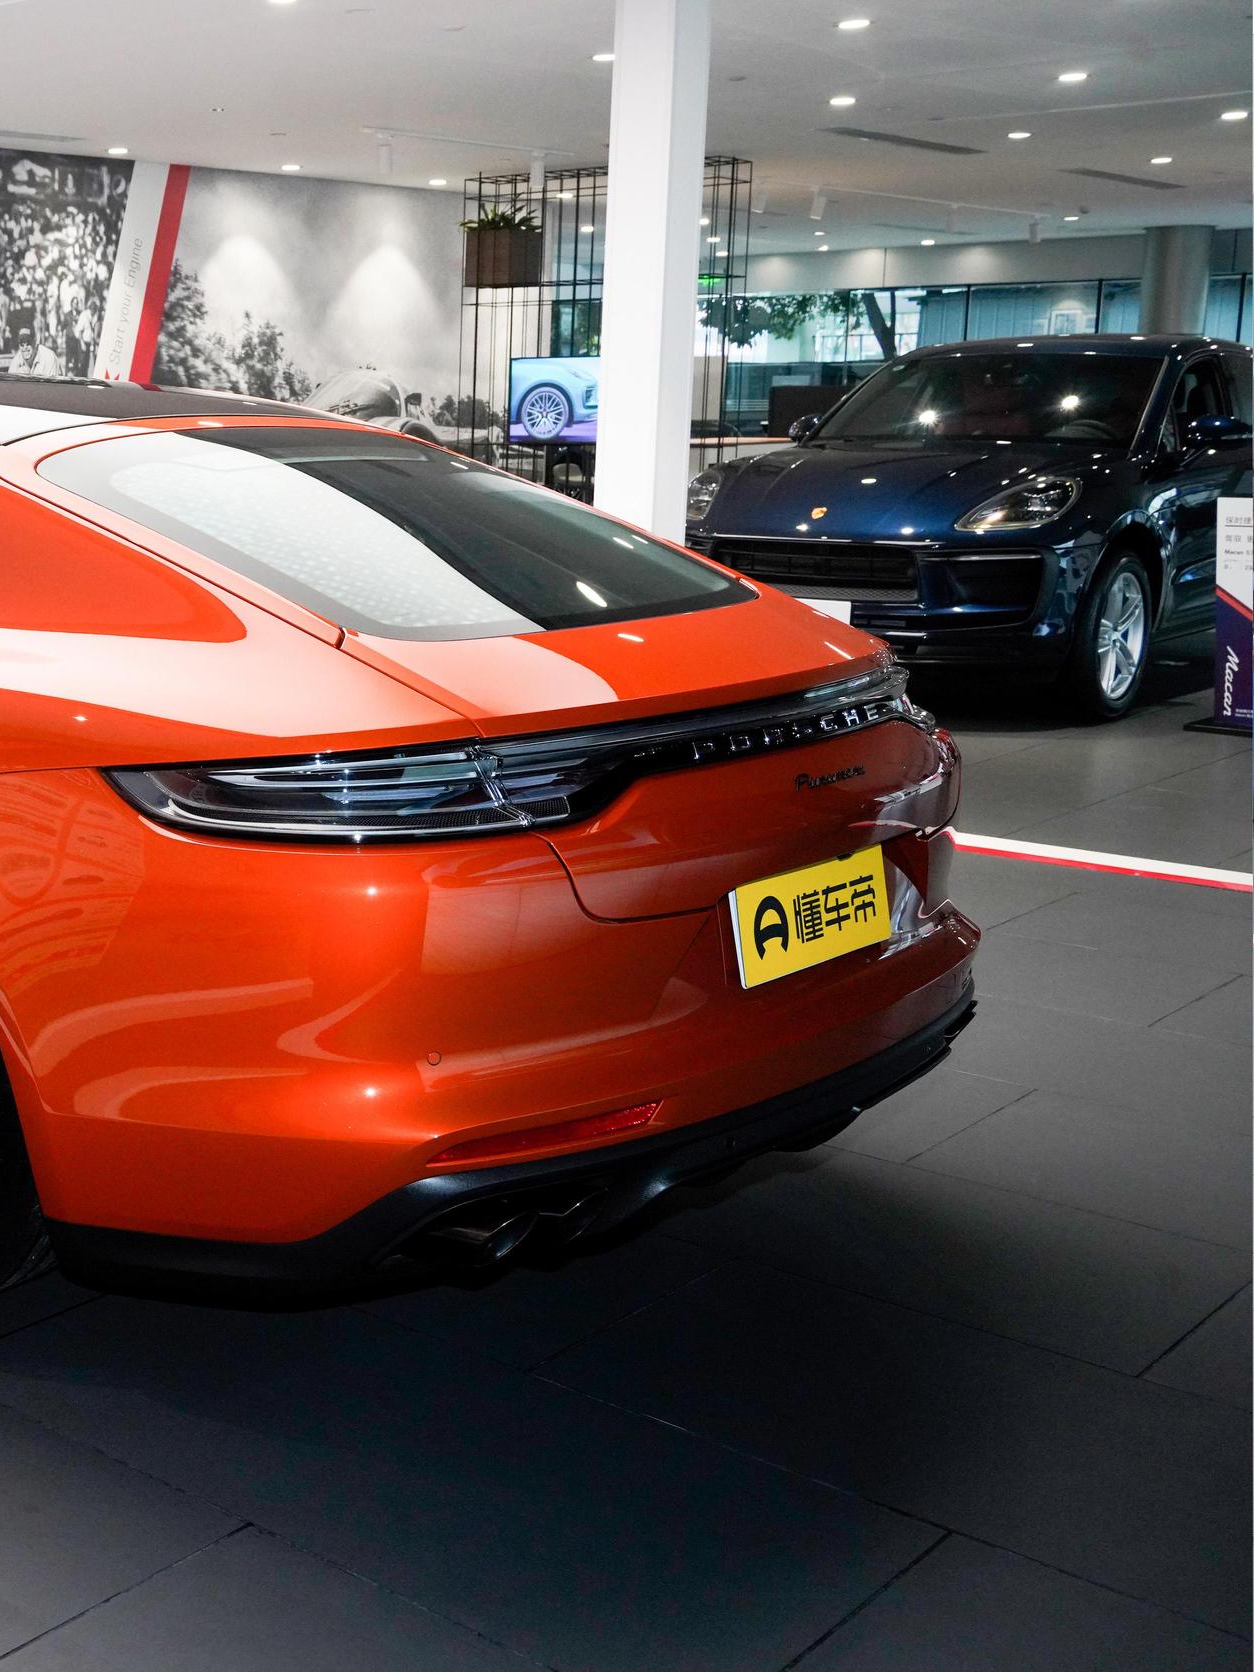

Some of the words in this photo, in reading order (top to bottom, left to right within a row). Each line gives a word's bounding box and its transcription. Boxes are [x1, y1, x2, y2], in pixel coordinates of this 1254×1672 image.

[123, 238, 144, 288] Engine
[120, 292, 134, 324] your
[108, 326, 125, 366] Start
[1223, 645, 1240, 716] Macan
[692, 704, 880, 760] PORSCHE
[793, 874, 877, 944] 懂车帝
